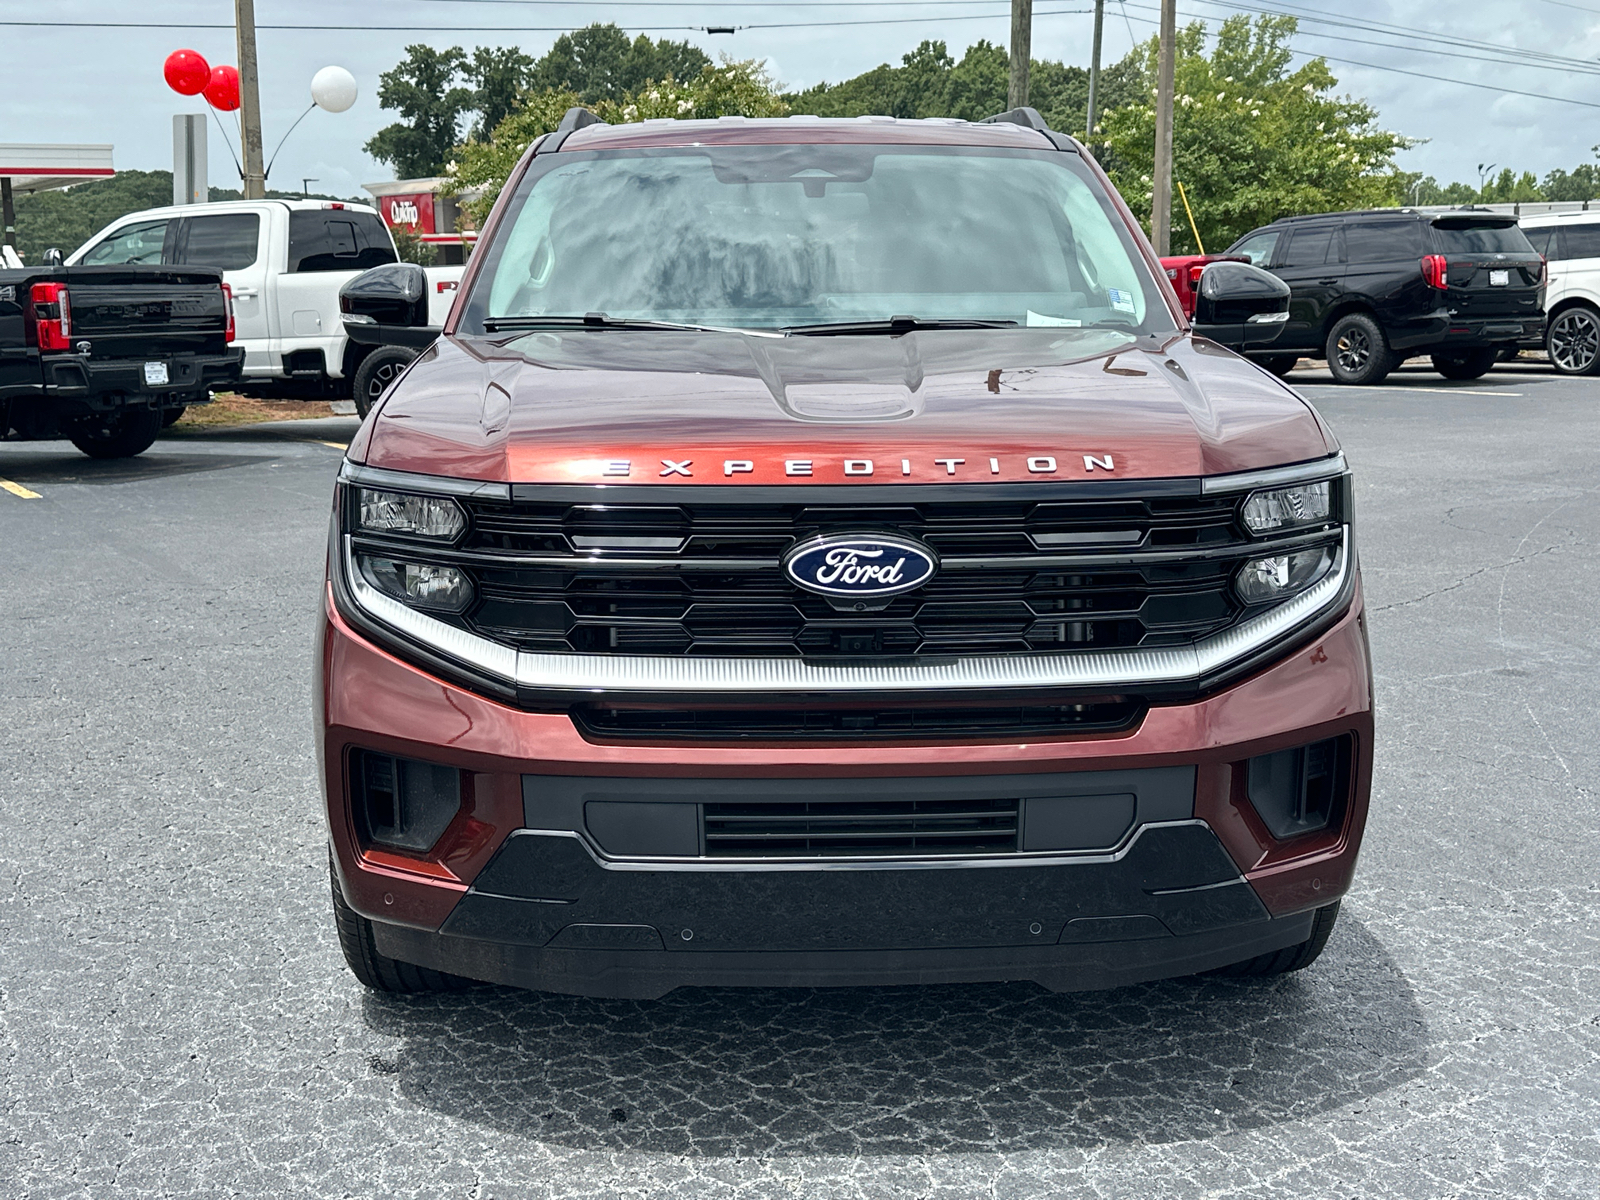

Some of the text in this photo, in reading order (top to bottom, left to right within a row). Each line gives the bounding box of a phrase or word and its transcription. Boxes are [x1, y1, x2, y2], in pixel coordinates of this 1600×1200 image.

[96, 303, 208, 315] SUPER DUTY
[602, 455, 1115, 477] EXPEDITION
[816, 548, 906, 584] Ford
